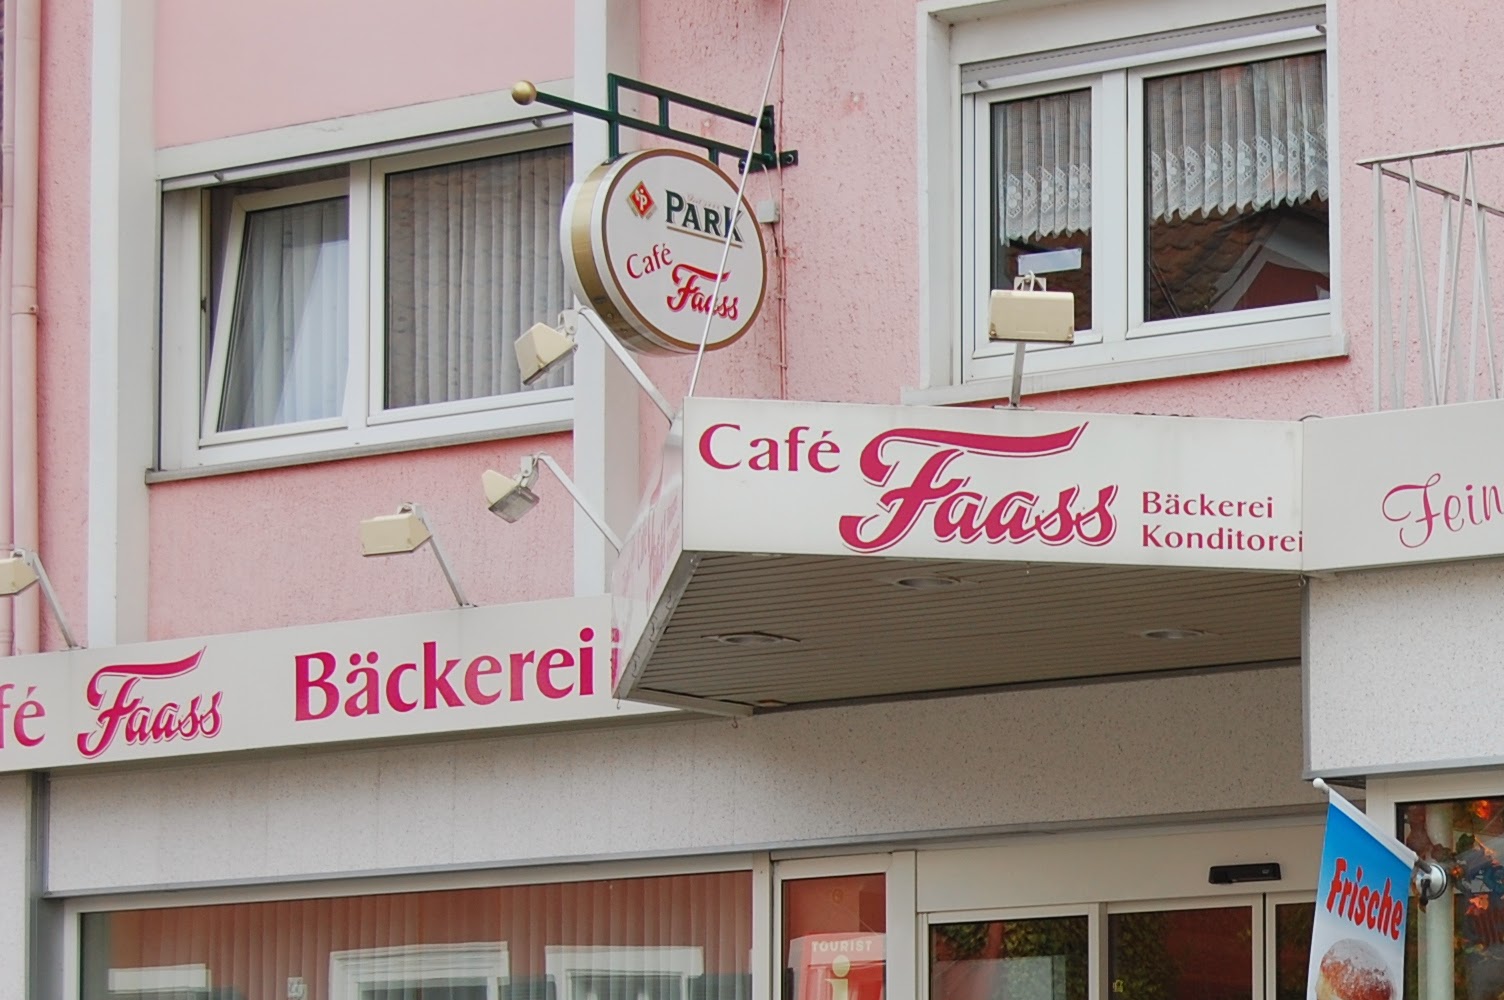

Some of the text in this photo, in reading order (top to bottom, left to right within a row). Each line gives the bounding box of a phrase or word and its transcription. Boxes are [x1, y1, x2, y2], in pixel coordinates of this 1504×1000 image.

[665, 189, 743, 243] PARK
[626, 243, 674, 279] Café
[698, 421, 1119, 554] Café Faass
[1141, 490, 1273, 519] Bäckerei
[1141, 523, 1303, 552] Konditorei
[76, 645, 224, 760] Faass
[294, 626, 595, 723] Bäckerei
[1326, 856, 1404, 941] Frische
[811, 941, 873, 953] TOURIST
